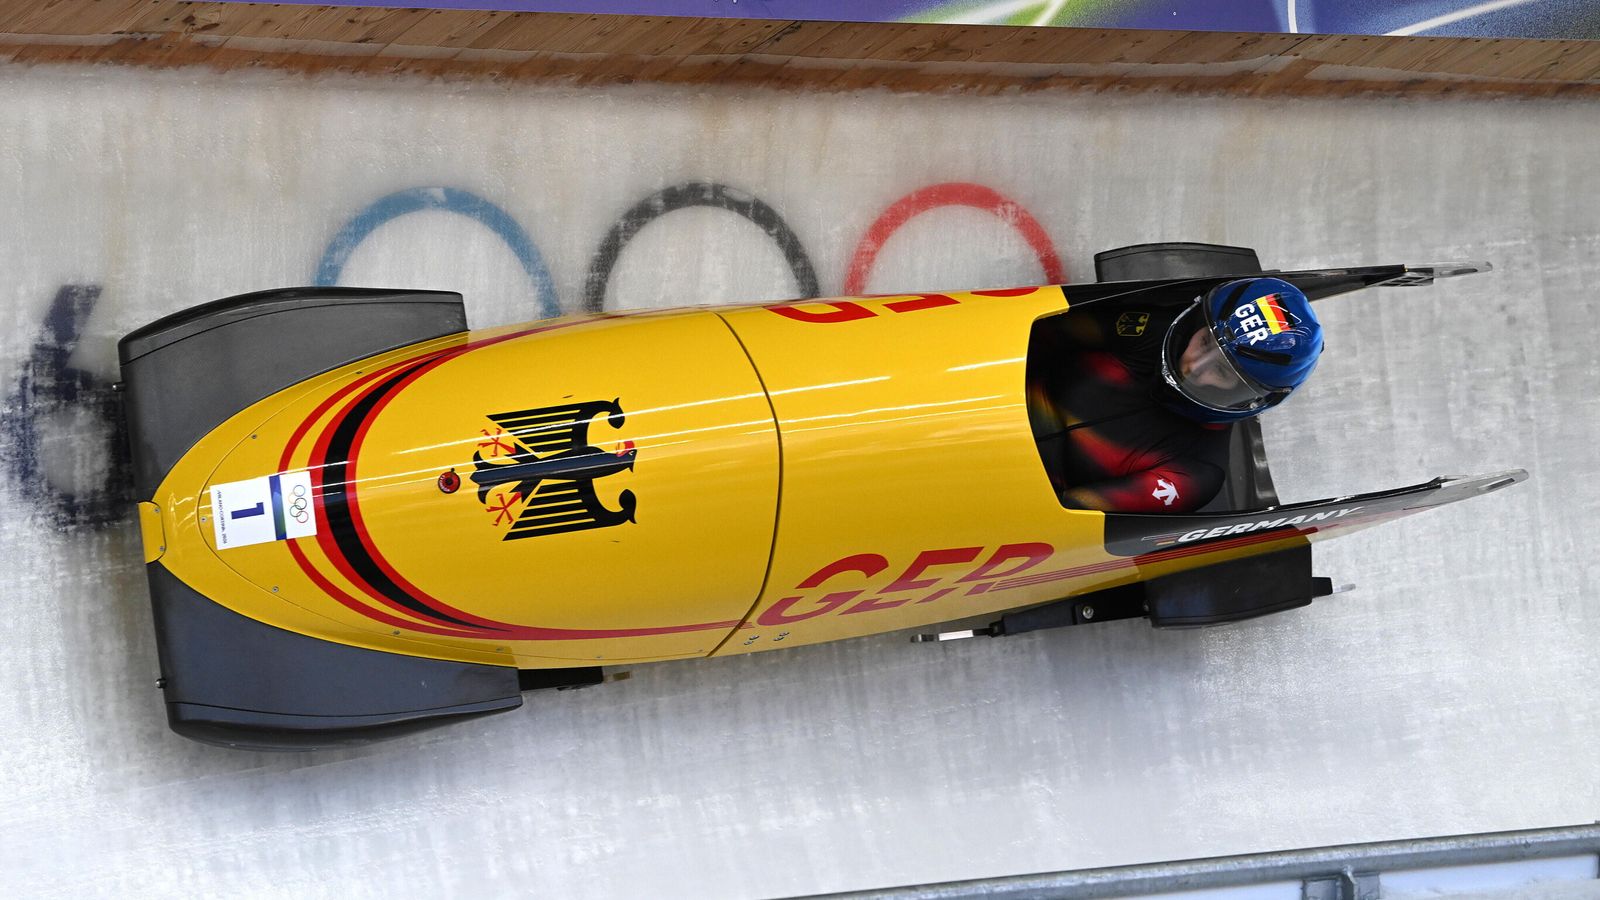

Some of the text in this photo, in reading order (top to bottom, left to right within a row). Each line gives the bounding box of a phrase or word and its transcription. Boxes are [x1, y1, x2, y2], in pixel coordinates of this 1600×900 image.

[1235, 303, 1269, 346] GER
[231, 502, 265, 520] 1
[1178, 506, 1364, 543] GERMANY
[756, 542, 1055, 626] GER
